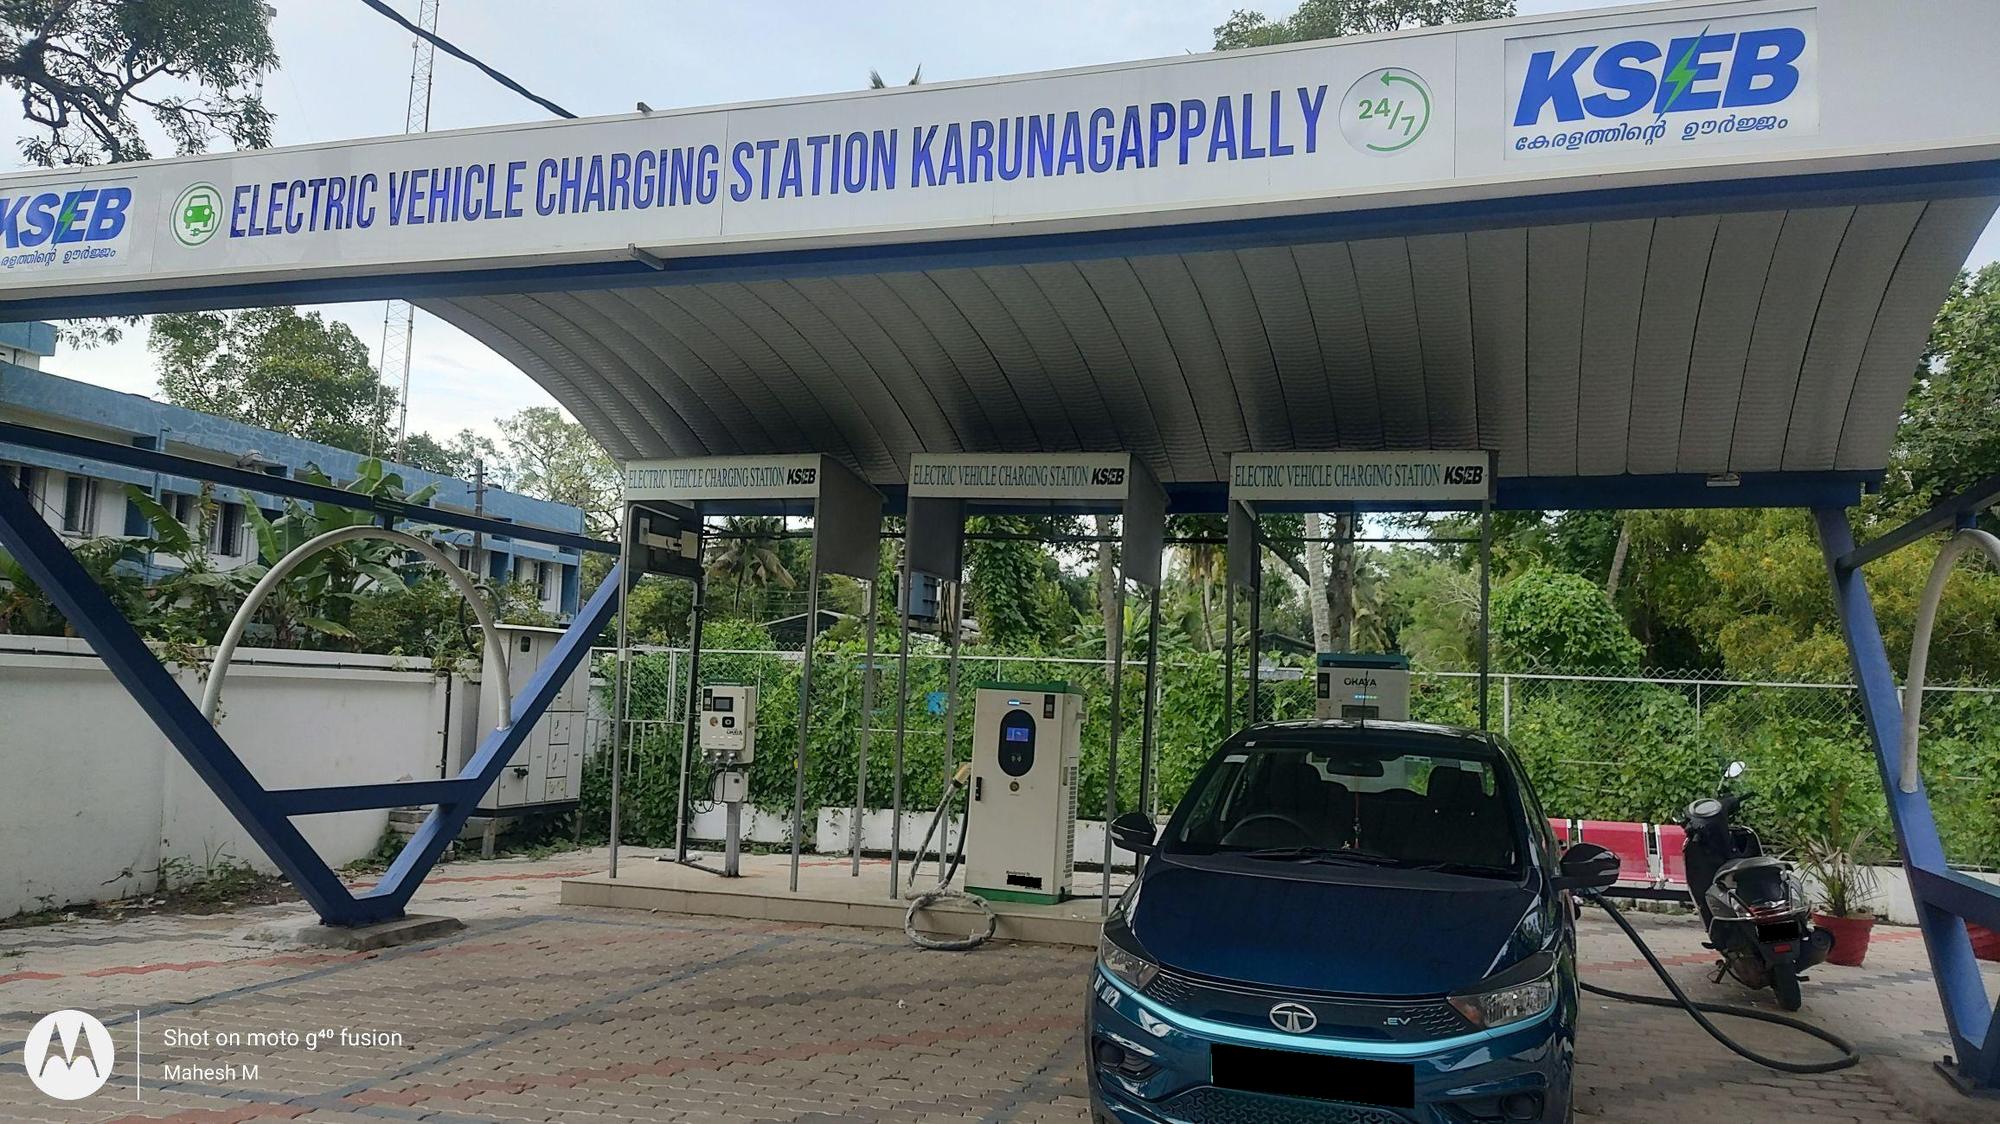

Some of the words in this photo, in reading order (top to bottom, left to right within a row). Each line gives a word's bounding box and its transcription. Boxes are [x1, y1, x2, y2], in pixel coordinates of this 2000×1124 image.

[1513, 27, 1806, 127] KSEB
[1359, 97, 1415, 136] 24/7
[229, 173, 378, 238] ELECTRIC
[389, 161, 527, 226] VEHICLE
[535, 144, 719, 217] CHARGING
[730, 129, 898, 202] STATION
[911, 85, 1328, 188] KARUNAGAPPALLY
[628, 469, 667, 489] ELECTRIC
[669, 468, 704, 488] VEHICLE
[704, 468, 749, 488] CHARGING
[750, 467, 785, 487] STATION
[787, 468, 816, 485] KSEB
[913, 465, 957, 486] ELECTRIC
[959, 465, 997, 486] VEHICLE
[999, 465, 1049, 486] CHARGING
[1050, 466, 1089, 486] STATION
[1091, 468, 1125, 485] KSEB
[1235, 465, 1284, 488] ELECTRIC
[1286, 464, 1332, 487] VEHICLE
[1334, 464, 1392, 487] CHARGING
[1395, 464, 1440, 487] STATION
[1443, 465, 1484, 485] KSEB
[1343, 677, 1377, 687] OKAYA
